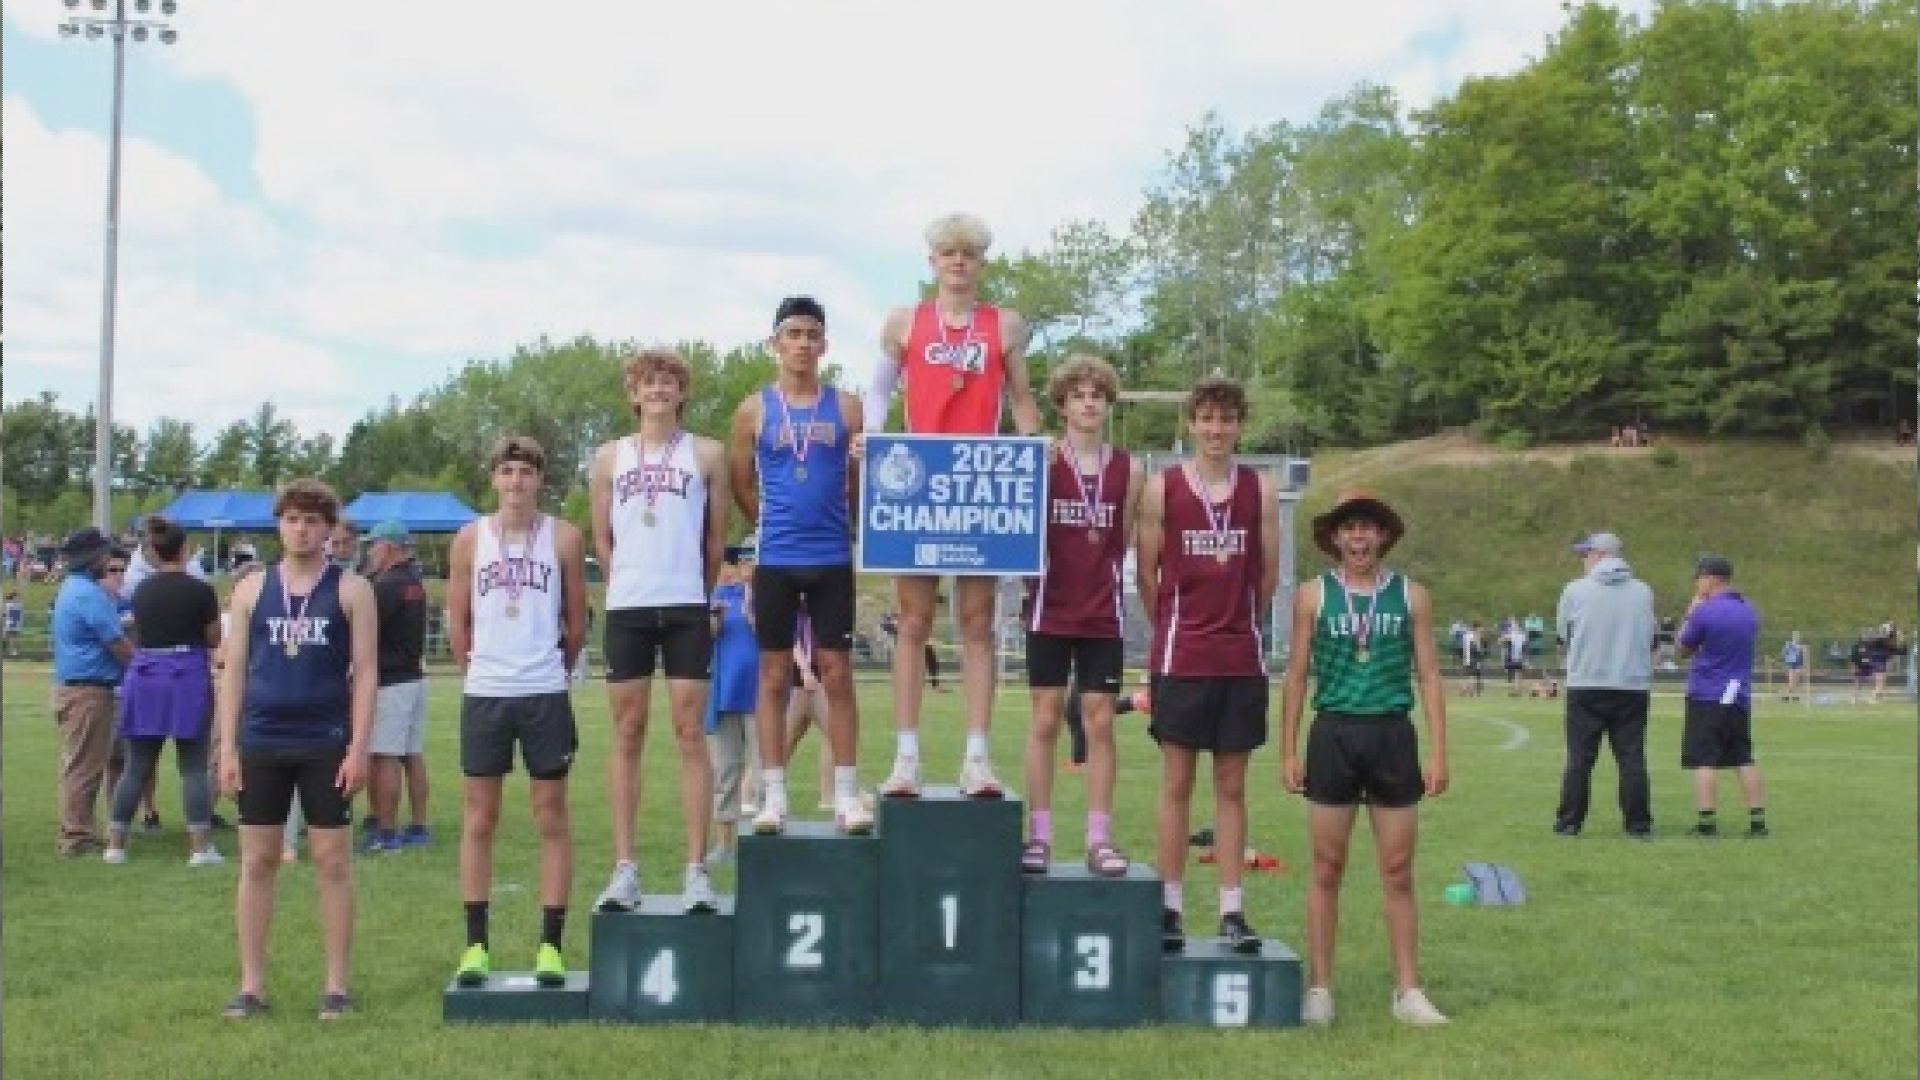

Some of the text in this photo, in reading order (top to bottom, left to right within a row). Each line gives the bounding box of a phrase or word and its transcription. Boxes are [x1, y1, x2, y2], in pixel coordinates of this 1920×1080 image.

[952, 443, 1036, 471] 2024
[616, 467, 694, 506] GRLY
[929, 474, 1034, 503] STATE
[869, 505, 1034, 534] CHAMPION
[1053, 498, 1117, 528] FREERT
[1181, 529, 1249, 556] FREERT
[477, 558, 552, 597] GRLY
[1327, 612, 1404, 639] LEITT
[787, 914, 825, 967] 2
[941, 895, 957, 947] 1
[641, 949, 679, 1004] 4
[1074, 935, 1110, 989] 3
[1213, 973, 1250, 1025] 5
